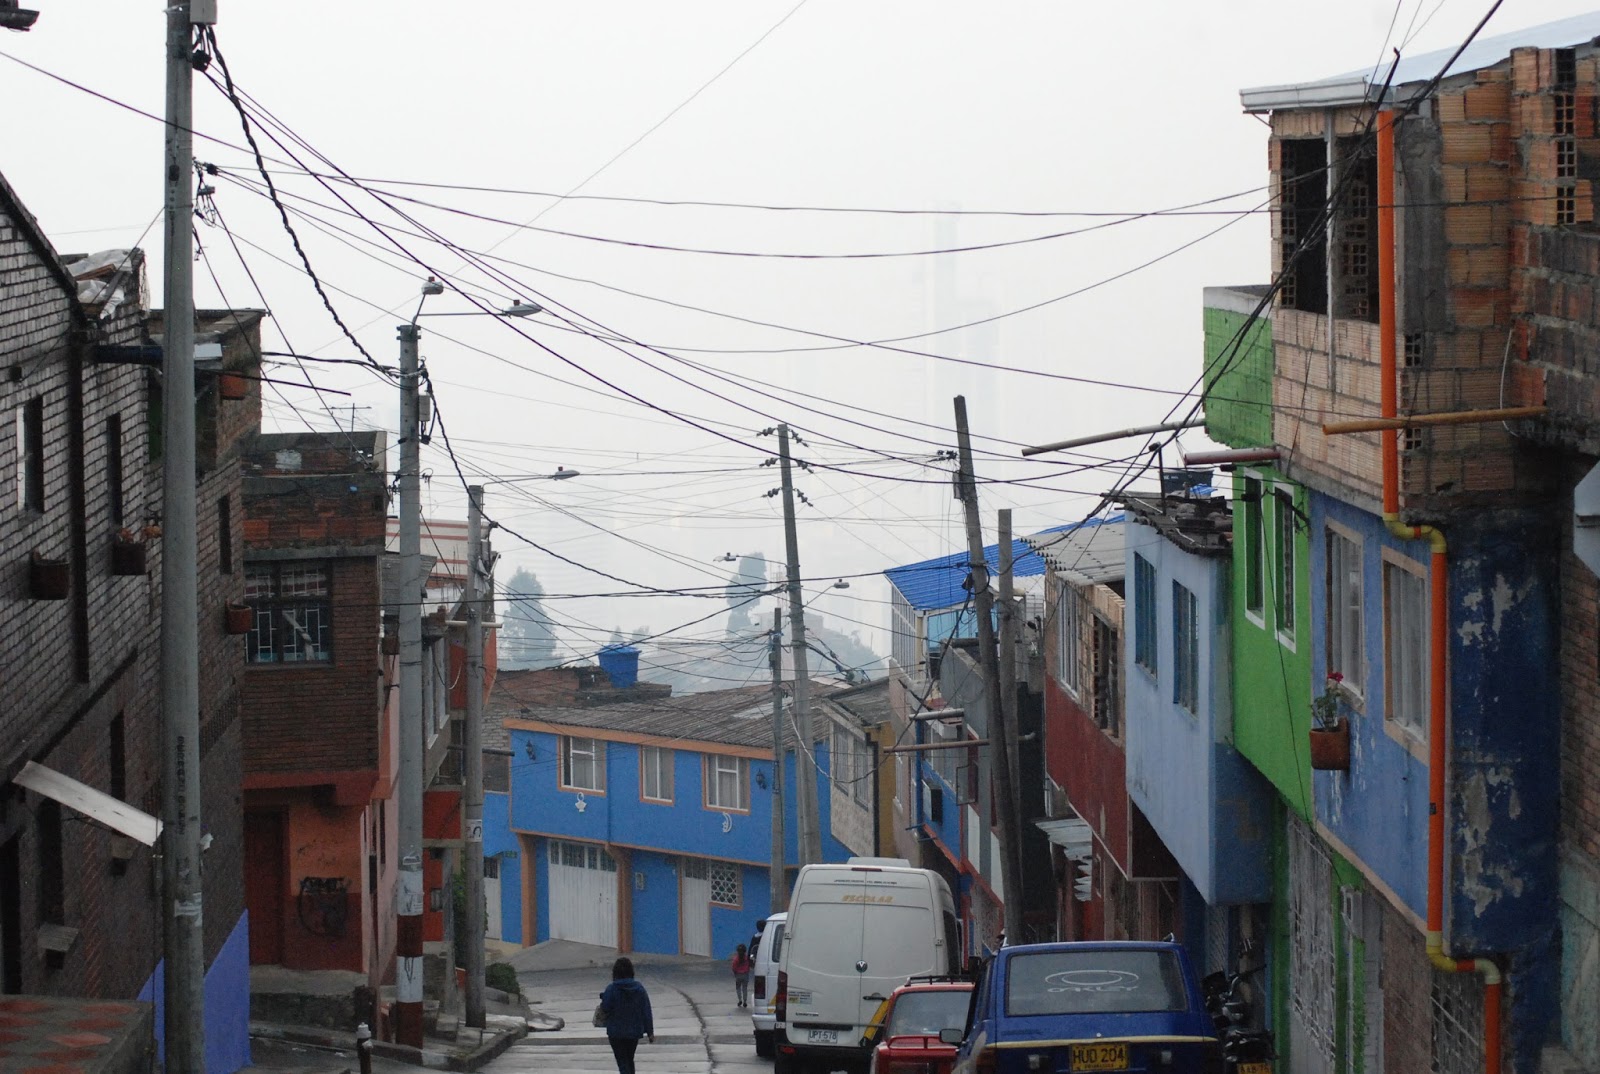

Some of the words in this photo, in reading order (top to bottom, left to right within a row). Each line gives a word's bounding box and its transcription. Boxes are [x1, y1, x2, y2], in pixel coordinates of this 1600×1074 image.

[842, 895, 893, 903] ESCOLAR
[1073, 1049, 1097, 1064] HUD
[1101, 1047, 1125, 1063] 204
